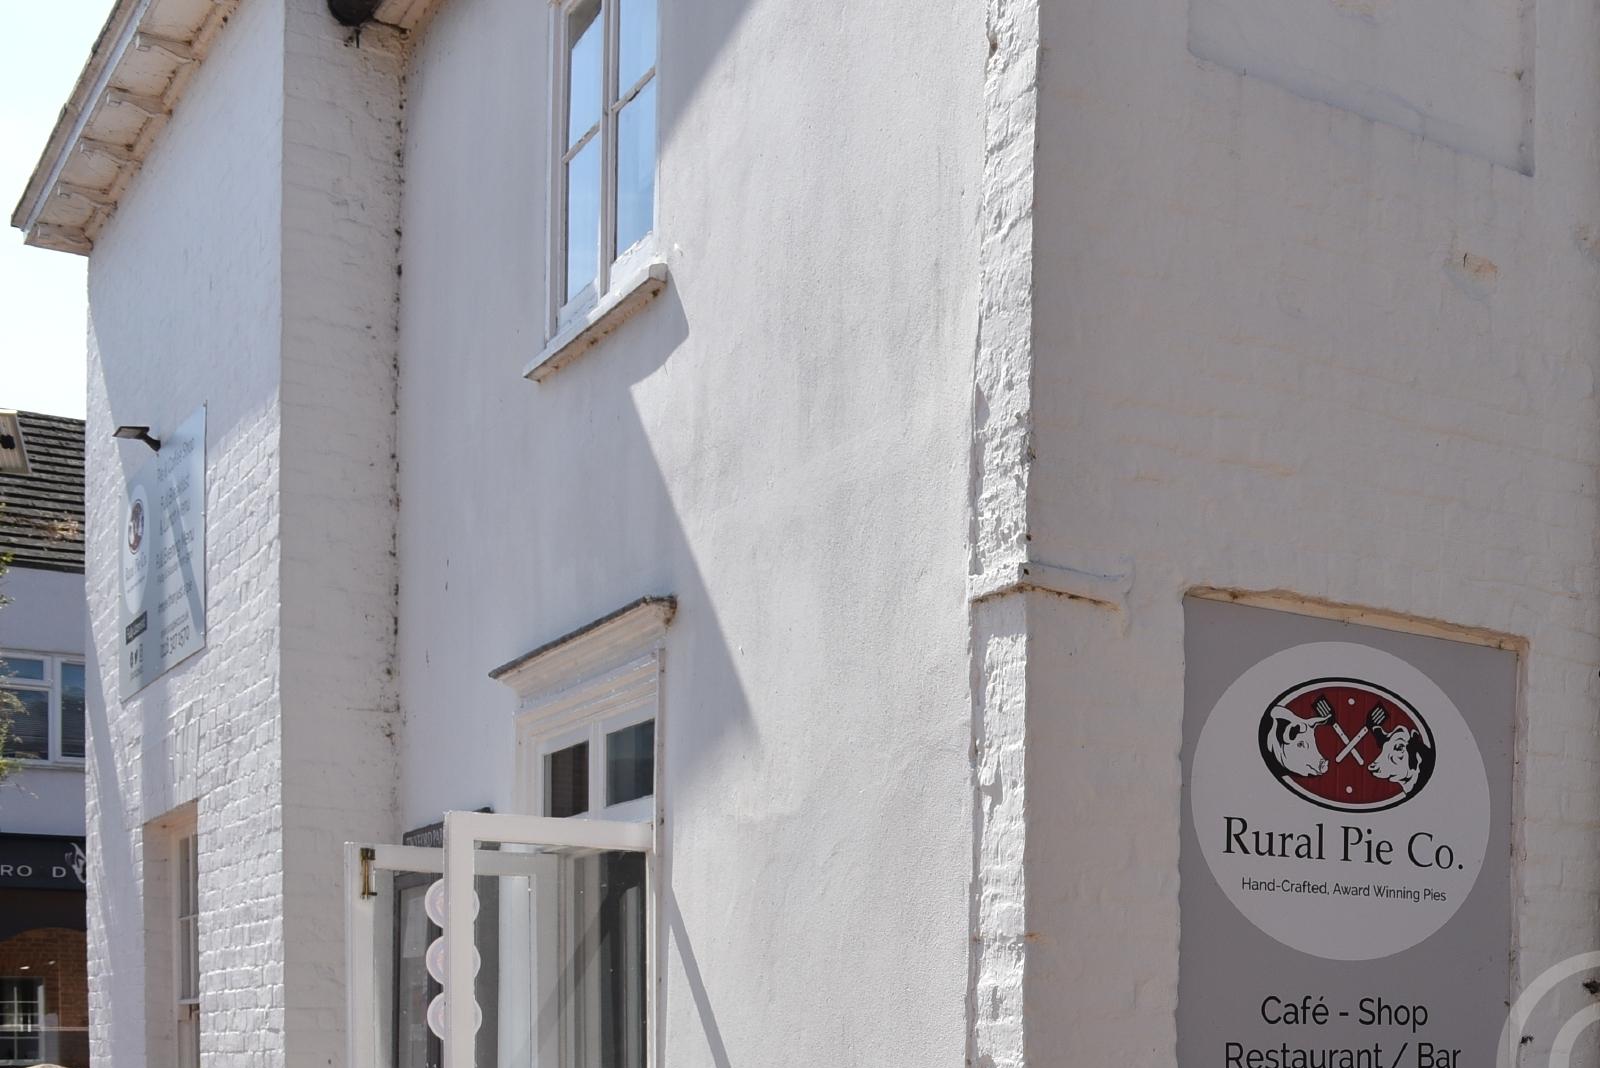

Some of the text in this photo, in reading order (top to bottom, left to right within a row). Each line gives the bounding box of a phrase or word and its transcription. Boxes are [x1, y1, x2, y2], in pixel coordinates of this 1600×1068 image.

[1222, 816, 1464, 870] Rural Pie Co.
[1241, 877, 1447, 902] Hand-Crafted, Award Winning Pies
[1260, 995, 1330, 1026] Café
[1358, 997, 1429, 1033] Shop
